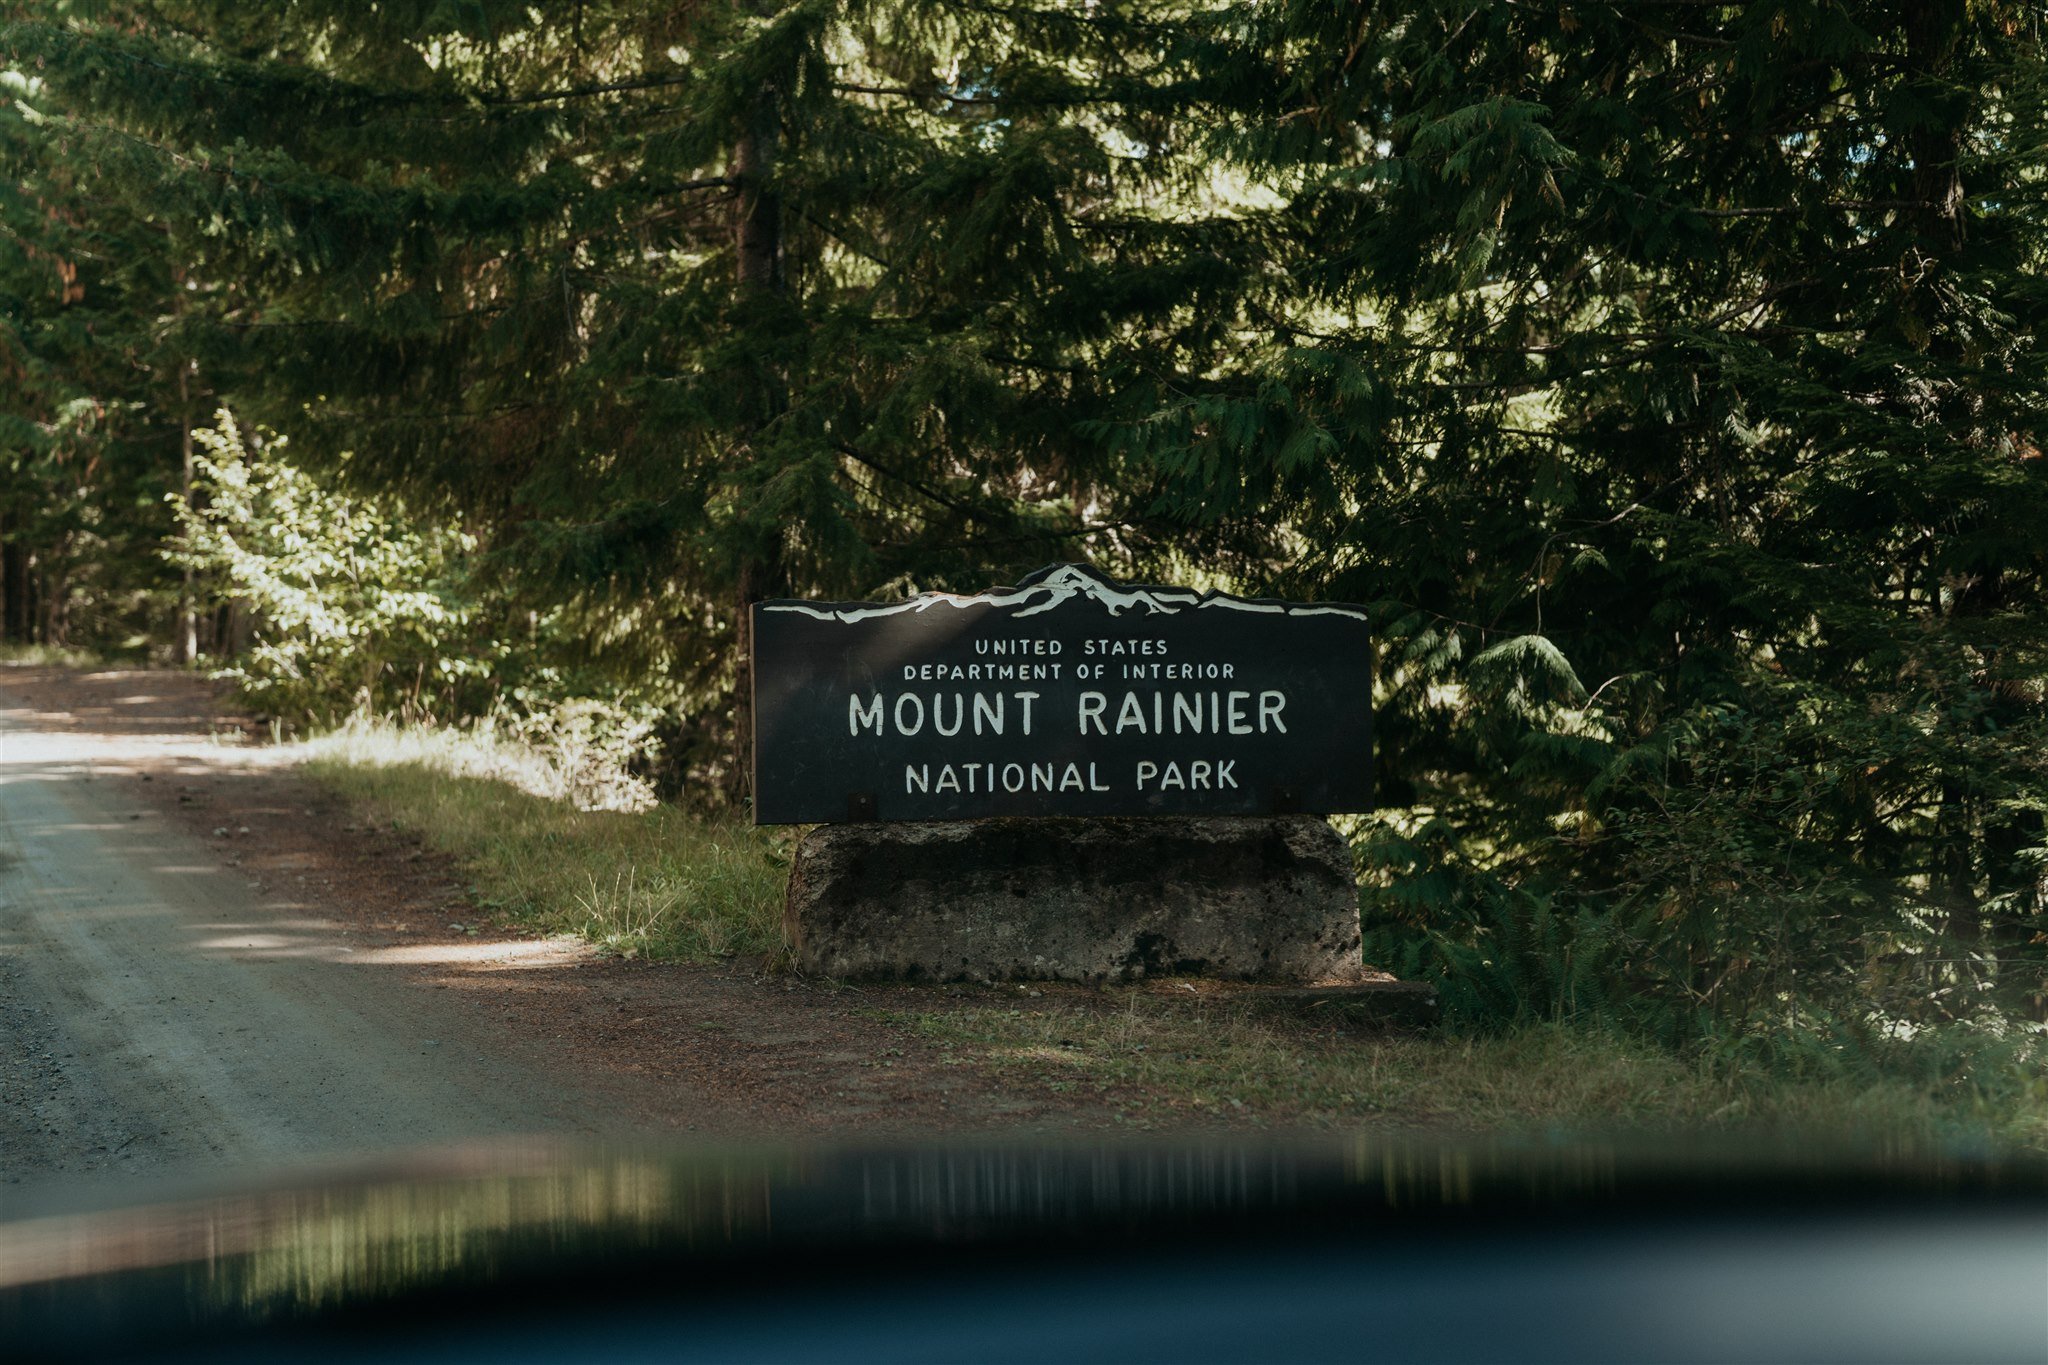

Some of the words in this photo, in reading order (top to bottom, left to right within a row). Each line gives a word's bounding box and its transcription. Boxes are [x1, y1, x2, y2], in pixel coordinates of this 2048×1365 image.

[975, 639, 1062, 655] UNITED
[1084, 639, 1168, 655] STATES
[904, 664, 1062, 681] DEPARTMENT
[1076, 663, 1105, 680] OF
[1122, 663, 1235, 680] INTERIOR
[849, 691, 1041, 737] MOUNT
[1078, 690, 1288, 736] RAINIER
[905, 761, 1110, 794] NATIONAL
[1136, 759, 1239, 791] PARK
